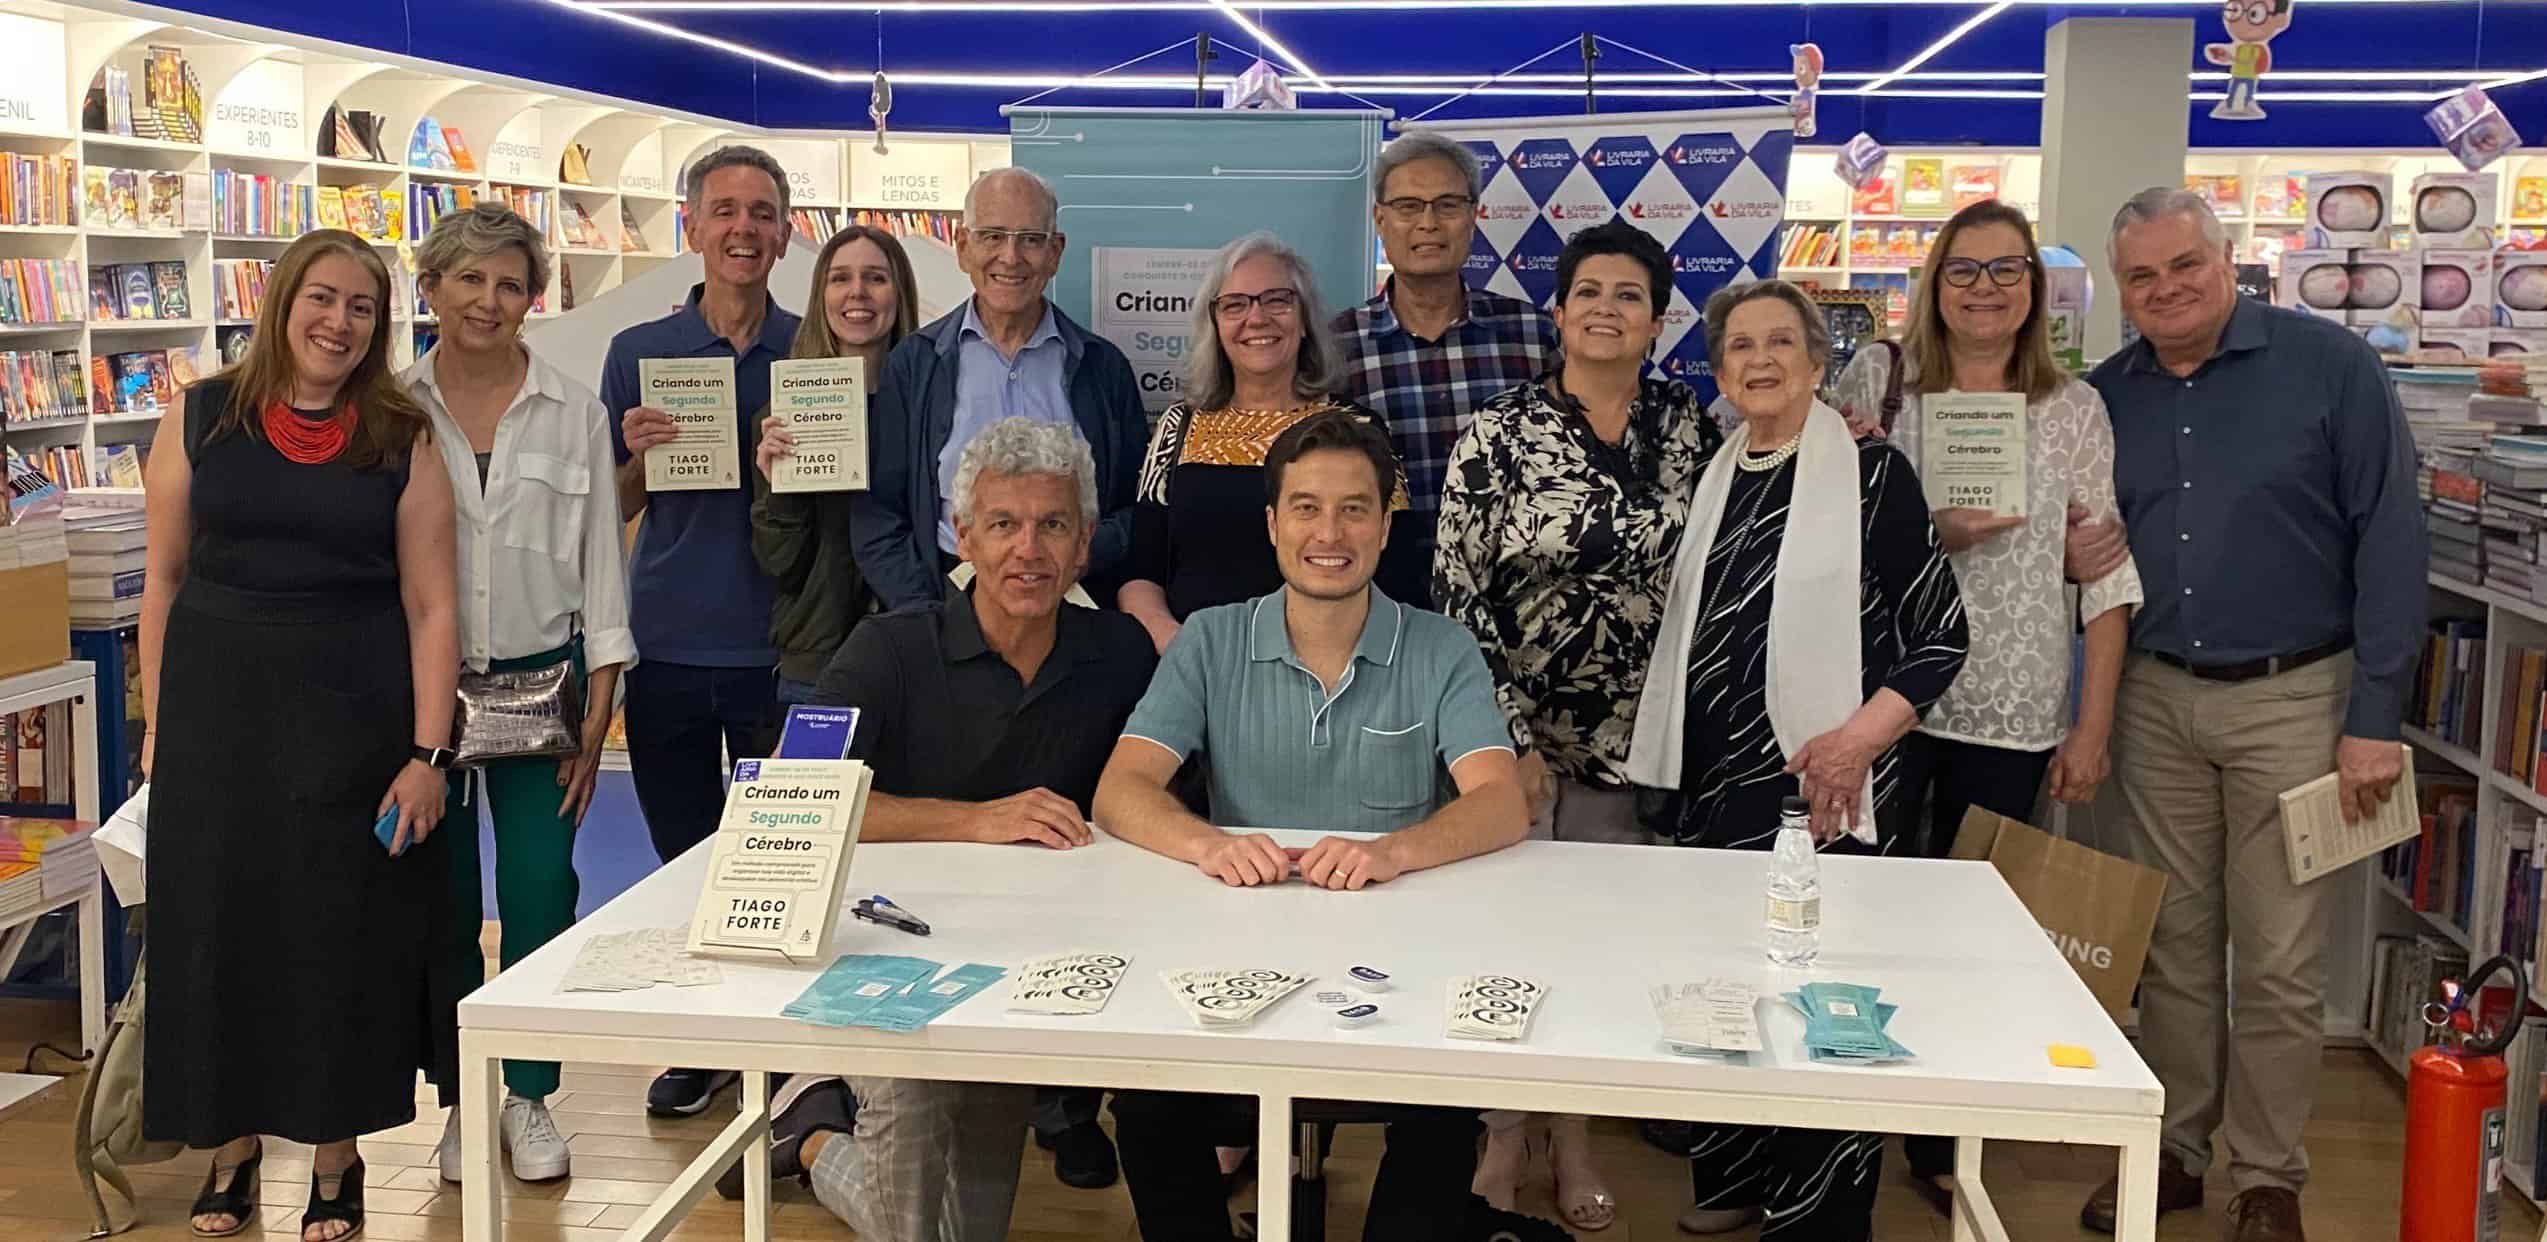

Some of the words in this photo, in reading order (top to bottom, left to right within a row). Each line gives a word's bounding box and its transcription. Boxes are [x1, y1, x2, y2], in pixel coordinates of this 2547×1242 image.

[216, 103, 298, 129] EXPERIENTES
[247, 131, 271, 148] 8-10
[1529, 153, 1570, 161] LIVRARIA
[1607, 150, 1650, 160] LIVRARIA
[1689, 147, 1736, 157] LIVRARIA
[1543, 160, 1563, 168] VILA
[1622, 158, 1642, 166] VILA
[1689, 156, 1704, 165] DA
[1705, 155, 1727, 164] VILA
[882, 175, 926, 188] MITOS
[931, 175, 939, 187] E
[882, 190, 940, 202] LENDAS
[1686, 257, 1735, 265] LIVRARIA
[1686, 264, 1701, 273] DA
[1703, 264, 1726, 273] VILA
[1115, 290, 1194, 313] Crian
[652, 378, 701, 388] Criando
[704, 379, 724, 388] um
[782, 377, 829, 388] Criando
[832, 377, 853, 386] um
[791, 393, 845, 406] Segundo
[668, 454, 709, 464] TIAGO
[796, 453, 836, 464] TIAGO
[669, 466, 710, 475] FORTE
[796, 465, 836, 475] FORTE
[1948, 486, 1993, 495] TIAGO
[745, 785, 809, 800] Criando
[812, 788, 840, 801] um
[750, 810, 822, 828] Segundo
[745, 835, 812, 851] Cérebro
[731, 899, 786, 913] TIAGO
[726, 916, 783, 931] FORTE
